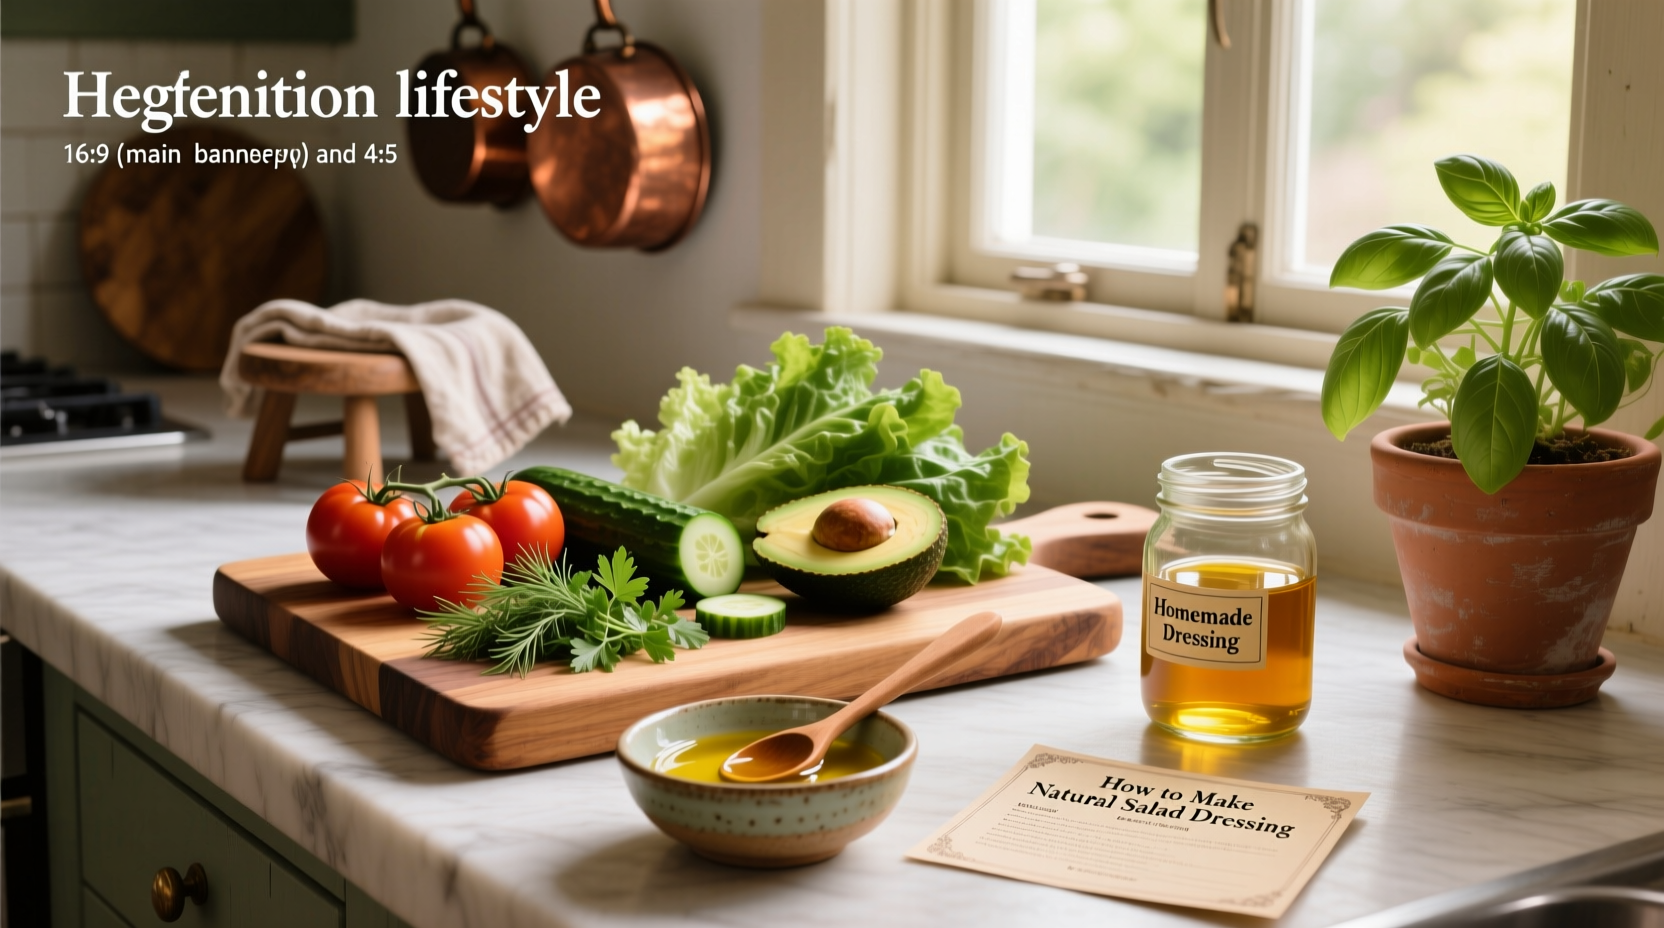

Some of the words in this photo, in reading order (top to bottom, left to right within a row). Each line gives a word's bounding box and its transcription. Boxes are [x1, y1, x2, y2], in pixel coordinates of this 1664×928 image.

[1154, 596, 1253, 626] Homemade
[1163, 623, 1241, 655] Dressing
[1026, 781, 1119, 809] Natural
[1120, 798, 1187, 820] Salad
[1188, 807, 1296, 840] Dressing
[1098, 775, 1156, 798] How
[1160, 788, 1184, 801] to
[1189, 790, 1255, 812] Make
